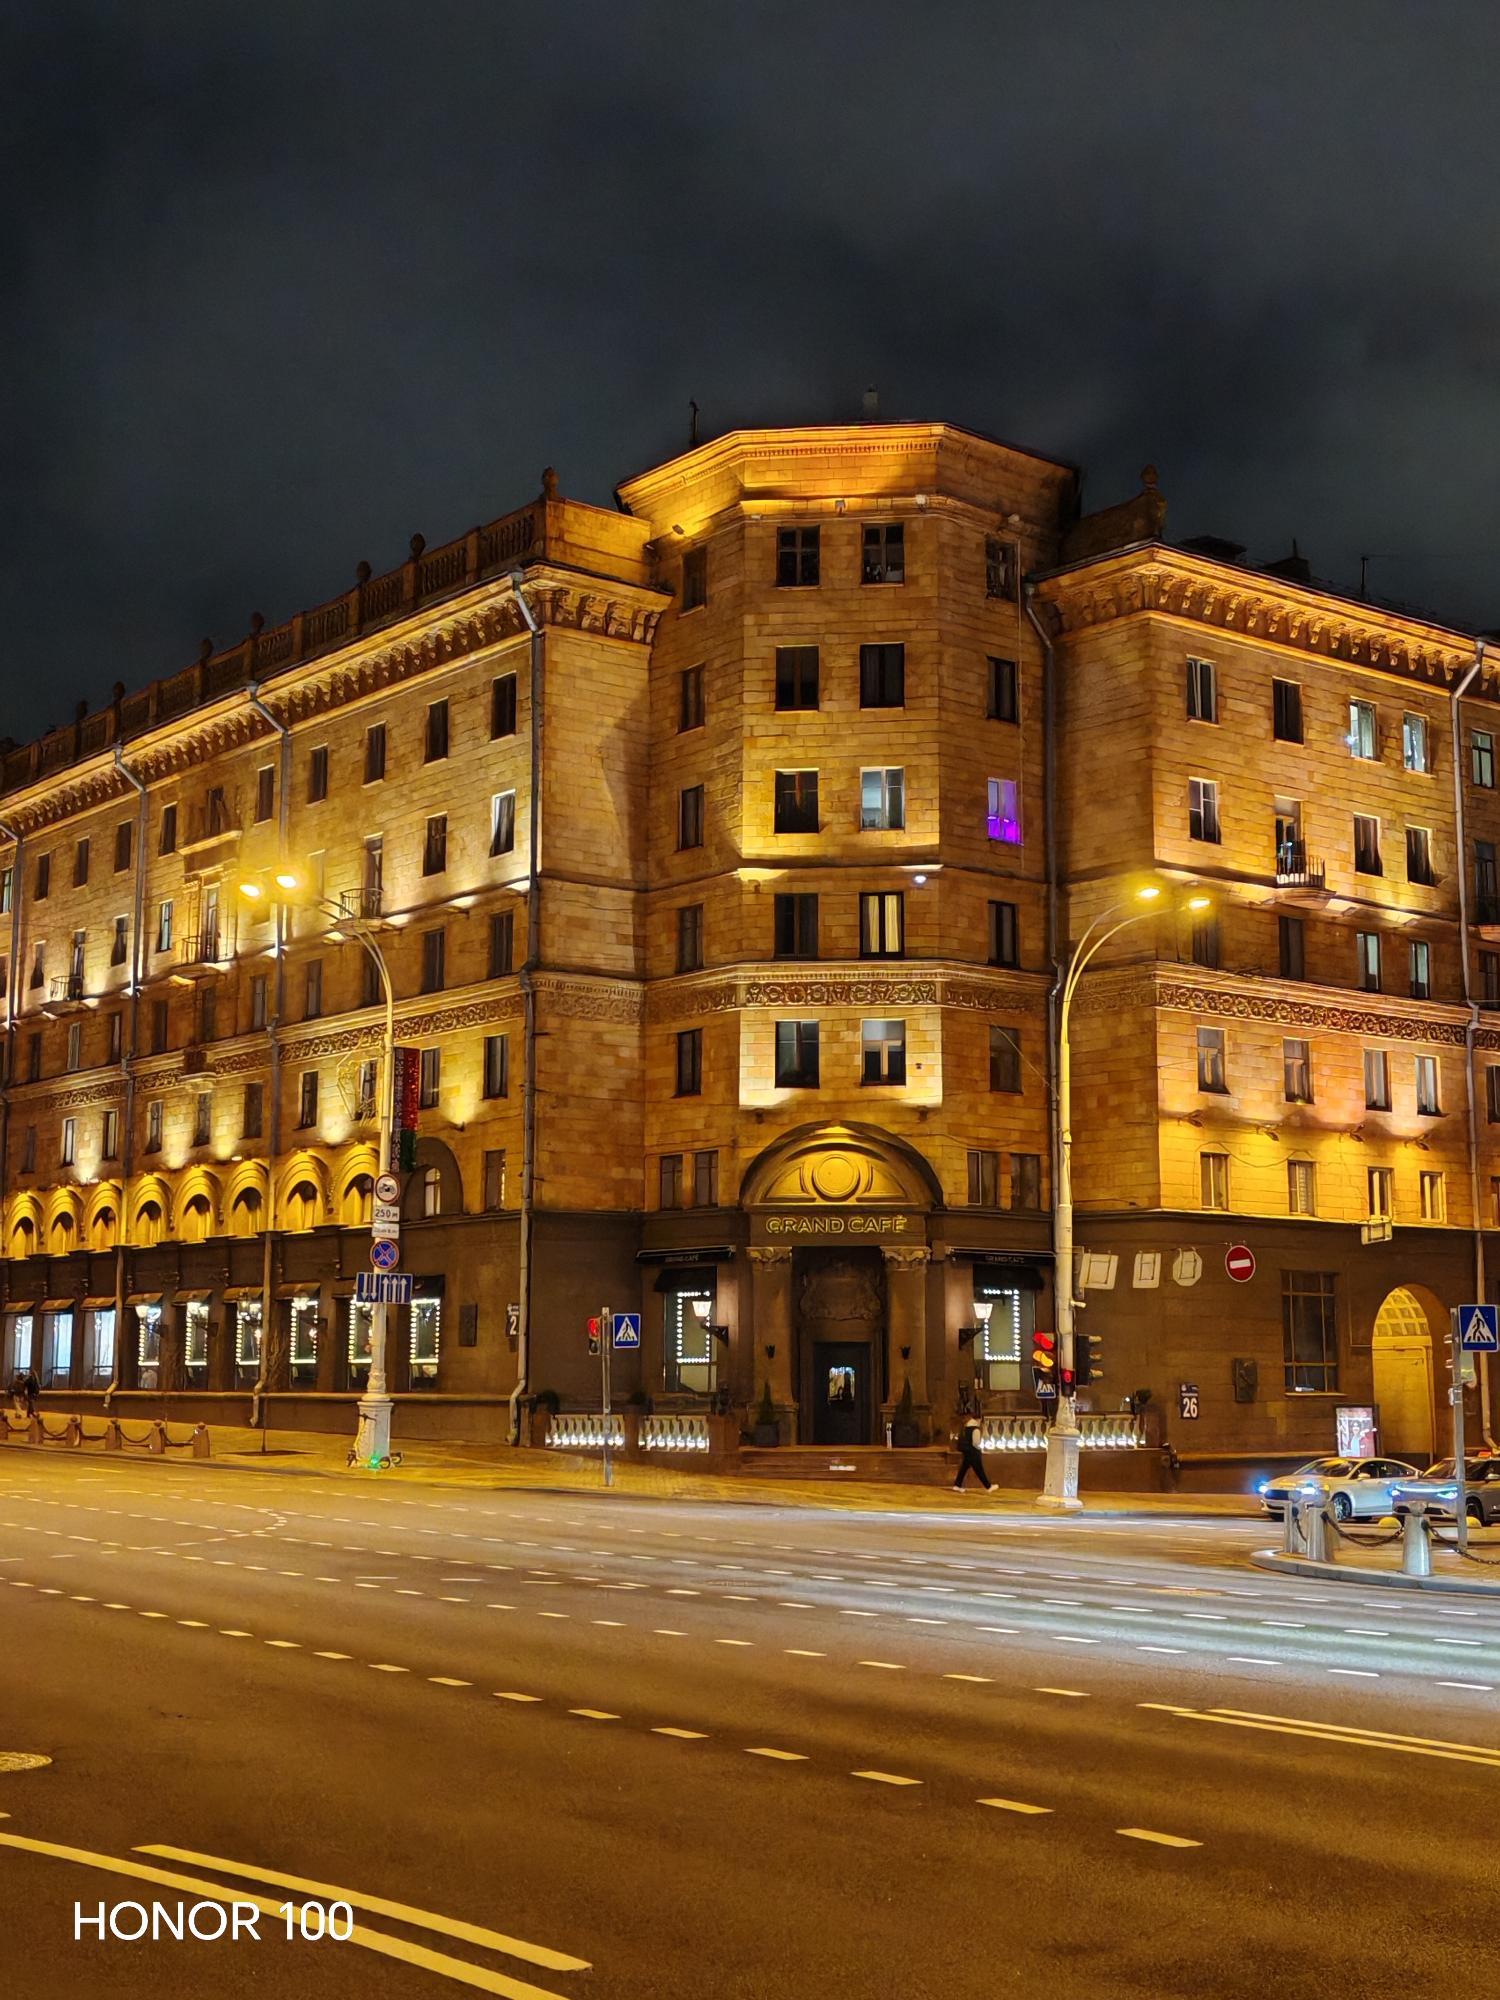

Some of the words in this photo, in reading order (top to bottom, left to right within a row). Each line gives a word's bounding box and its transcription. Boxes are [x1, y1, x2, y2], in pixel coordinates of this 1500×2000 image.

[375, 1209, 391, 1218] 250
[766, 1216, 845, 1233] GRAND
[847, 1215, 907, 1233] CAFÉ
[1183, 1397, 1198, 1418] 26
